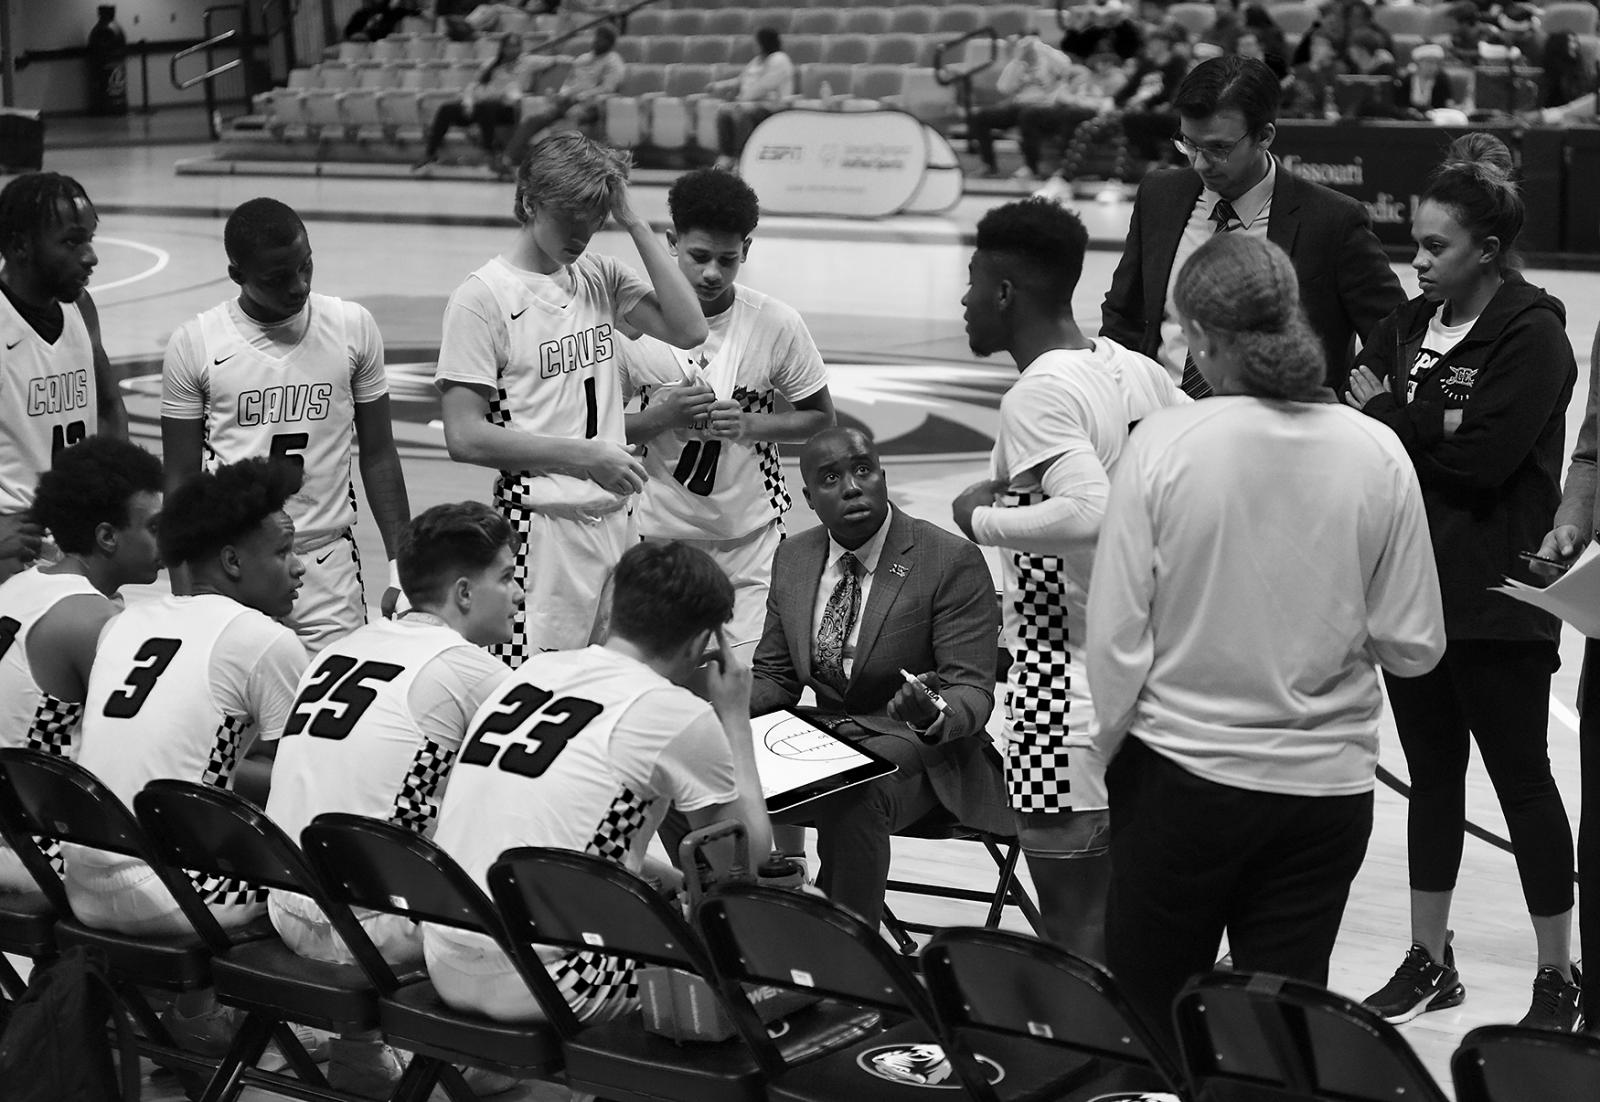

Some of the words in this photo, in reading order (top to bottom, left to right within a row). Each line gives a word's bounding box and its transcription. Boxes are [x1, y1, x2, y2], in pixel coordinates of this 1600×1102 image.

[539, 323, 613, 379] CAVS
[27, 369, 88, 416] CAVS
[237, 382, 332, 427] CAVS
[584, 376, 598, 439] 1
[102, 637, 182, 719] 3
[282, 654, 405, 741] 25
[460, 682, 604, 779] 23
